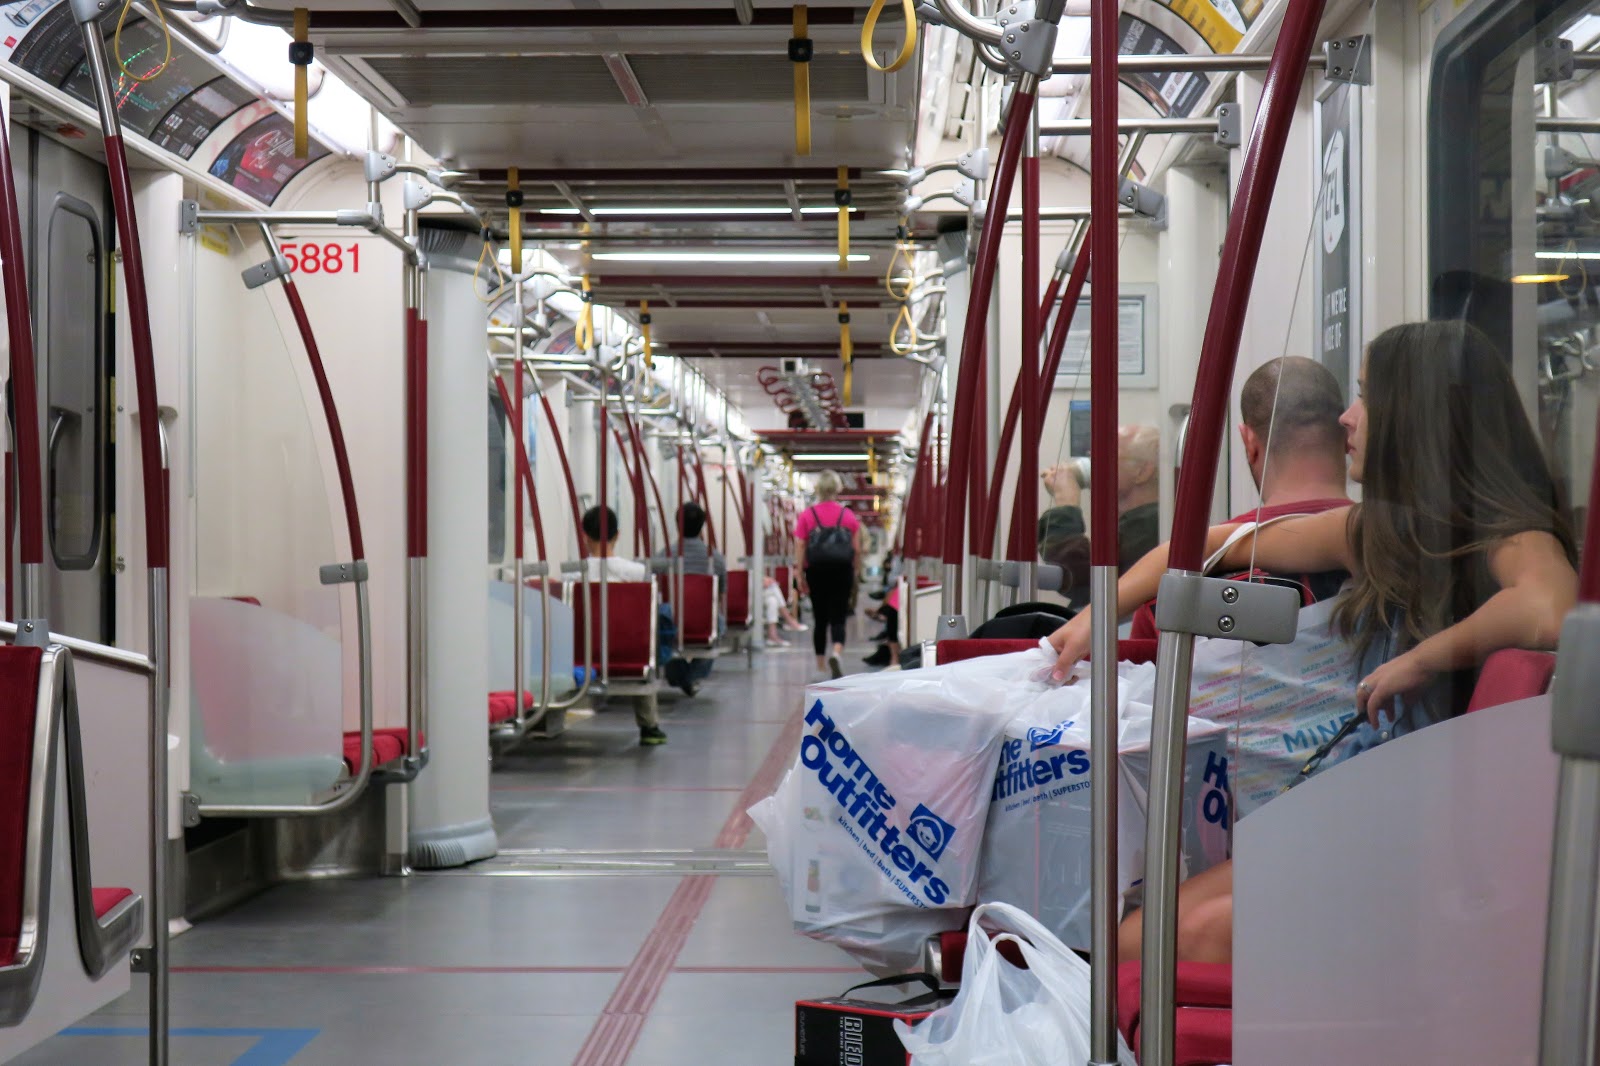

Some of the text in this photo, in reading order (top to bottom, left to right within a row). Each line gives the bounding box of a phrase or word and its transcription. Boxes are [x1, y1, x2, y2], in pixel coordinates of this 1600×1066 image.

[280, 243, 359, 274] 5881
[805, 698, 896, 811] Home
[991, 749, 1091, 803] tfitters
[1052, 780, 1091, 798] SUPERSTO
[801, 734, 950, 906] Outfitters
[838, 816, 860, 843] kitchen
[862, 843, 876, 859] bed
[877, 860, 892, 878] bath
[844, 1016, 863, 1066] RIED
